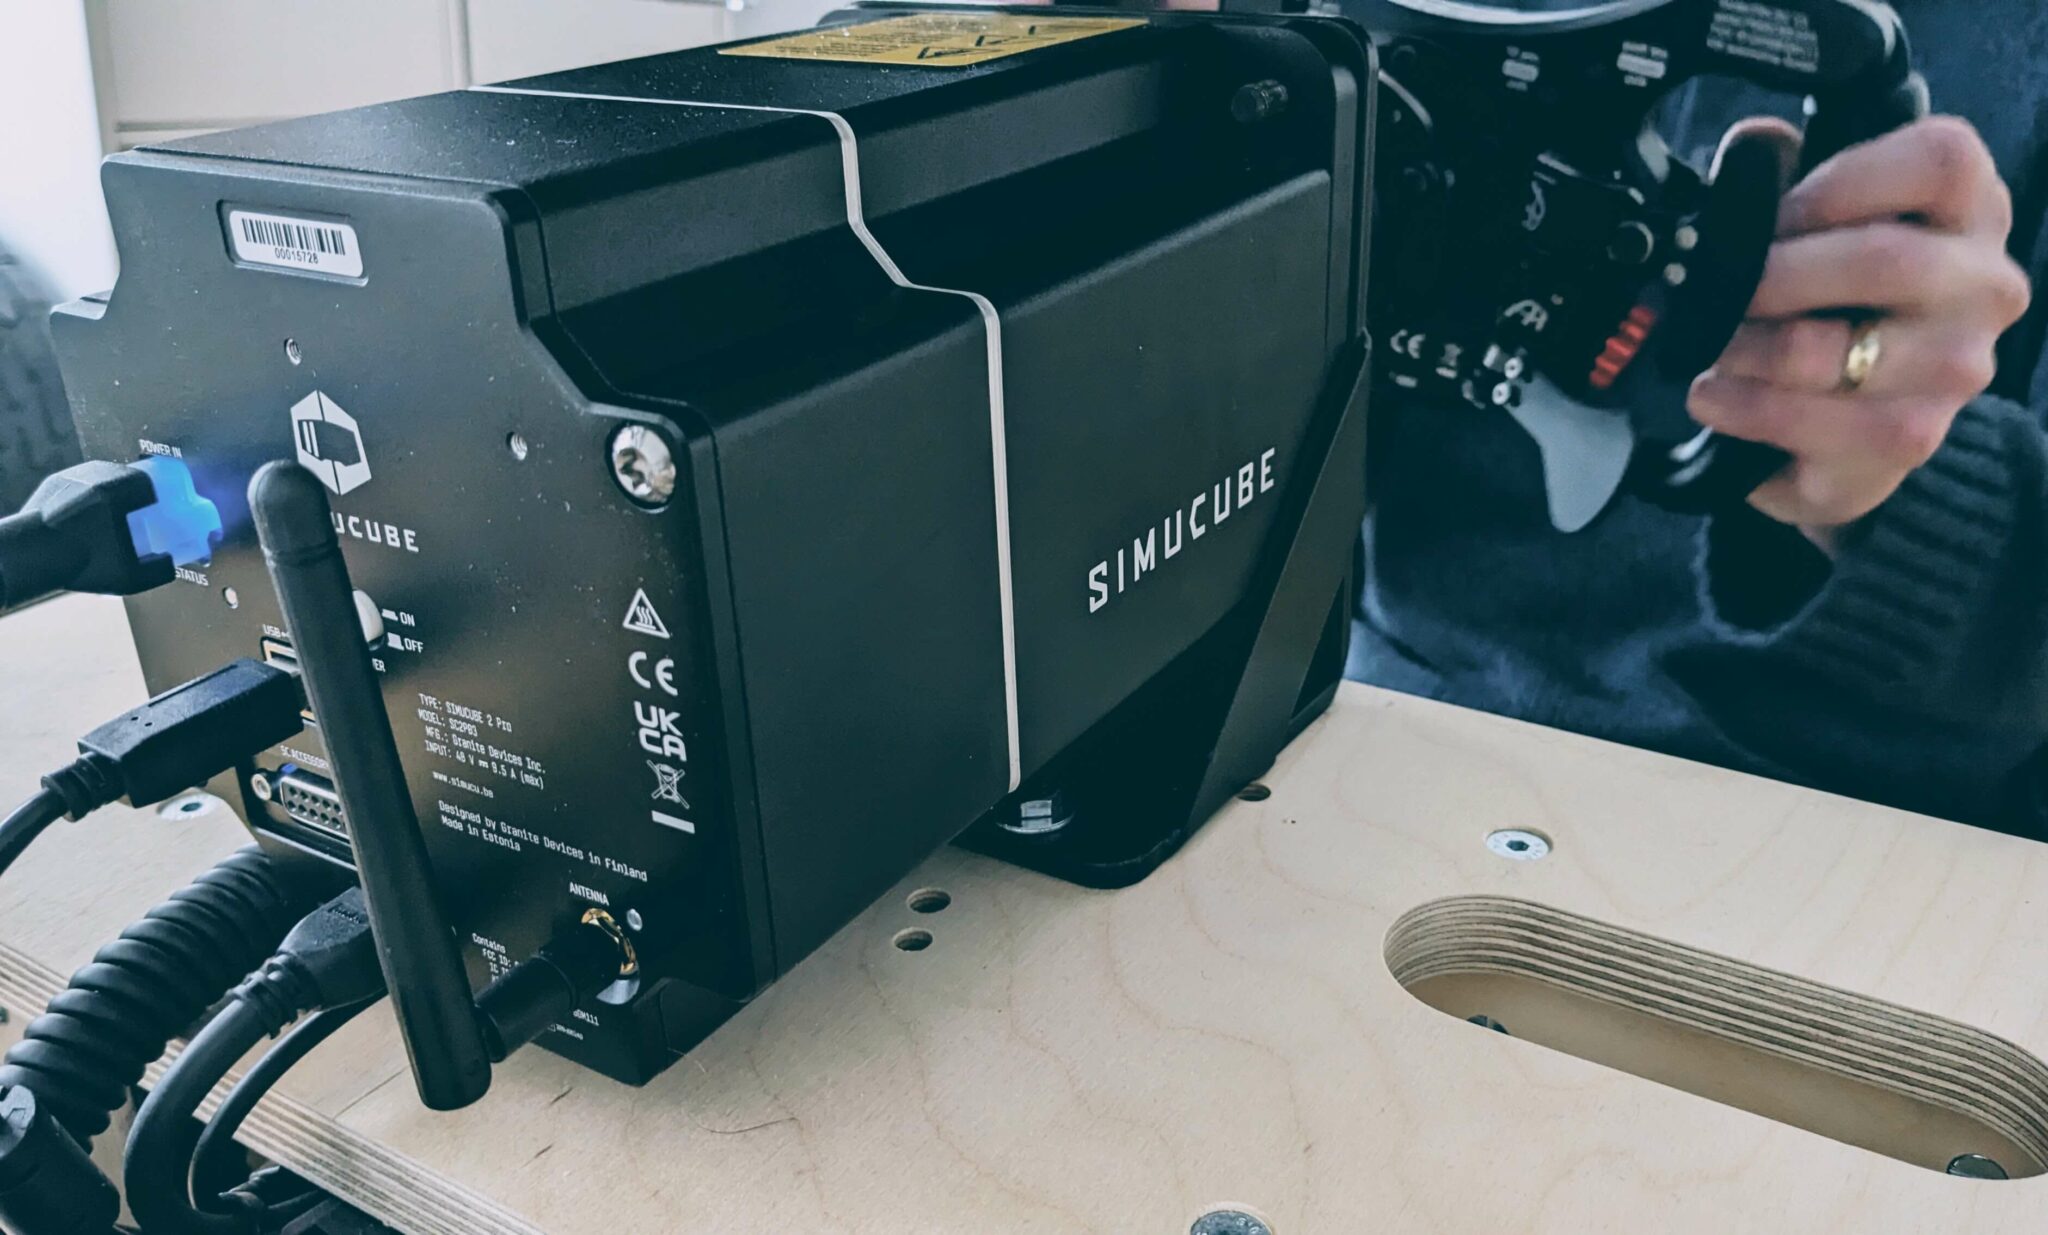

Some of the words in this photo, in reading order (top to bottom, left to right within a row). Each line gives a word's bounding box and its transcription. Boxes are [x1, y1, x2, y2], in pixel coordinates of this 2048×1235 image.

[274, 247, 319, 264] 00015728
[138, 438, 171, 456] POWER
[171, 446, 183, 459] IN
[330, 511, 420, 553] UCUBE
[1088, 447, 1275, 614] SIMUCUBE
[175, 567, 209, 586] STATUS
[400, 612, 415, 627] ON
[404, 638, 424, 653] OFF
[628, 651, 679, 697] CE
[417, 708, 446, 727] MODEL:
[418, 692, 442, 711] TYPE:
[445, 701, 484, 724] SIMUCUBE
[487, 714, 494, 727] 2
[496, 717, 512, 732] Pro
[425, 740, 452, 758] INPUT:
[468, 754, 474, 766] V
[511, 767, 517, 780] A
[520, 770, 544, 790] (max)
[452, 733, 485, 755] Granite
[488, 745, 523, 767] Devices
[526, 757, 546, 774] Inc.
[432, 771, 494, 798] www.simucu.be
[438, 800, 481, 825] Designed
[485, 816, 497, 831] by
[500, 822, 540, 845] Granite
[543, 836, 584, 860] Devices
[589, 851, 601, 866] in
[605, 857, 648, 882] Finland
[441, 815, 464, 832] Made
[468, 824, 479, 837] in
[482, 829, 521, 852] Estonia
[569, 881, 610, 906] ANTENNA
[472, 932, 506, 954] Contains
